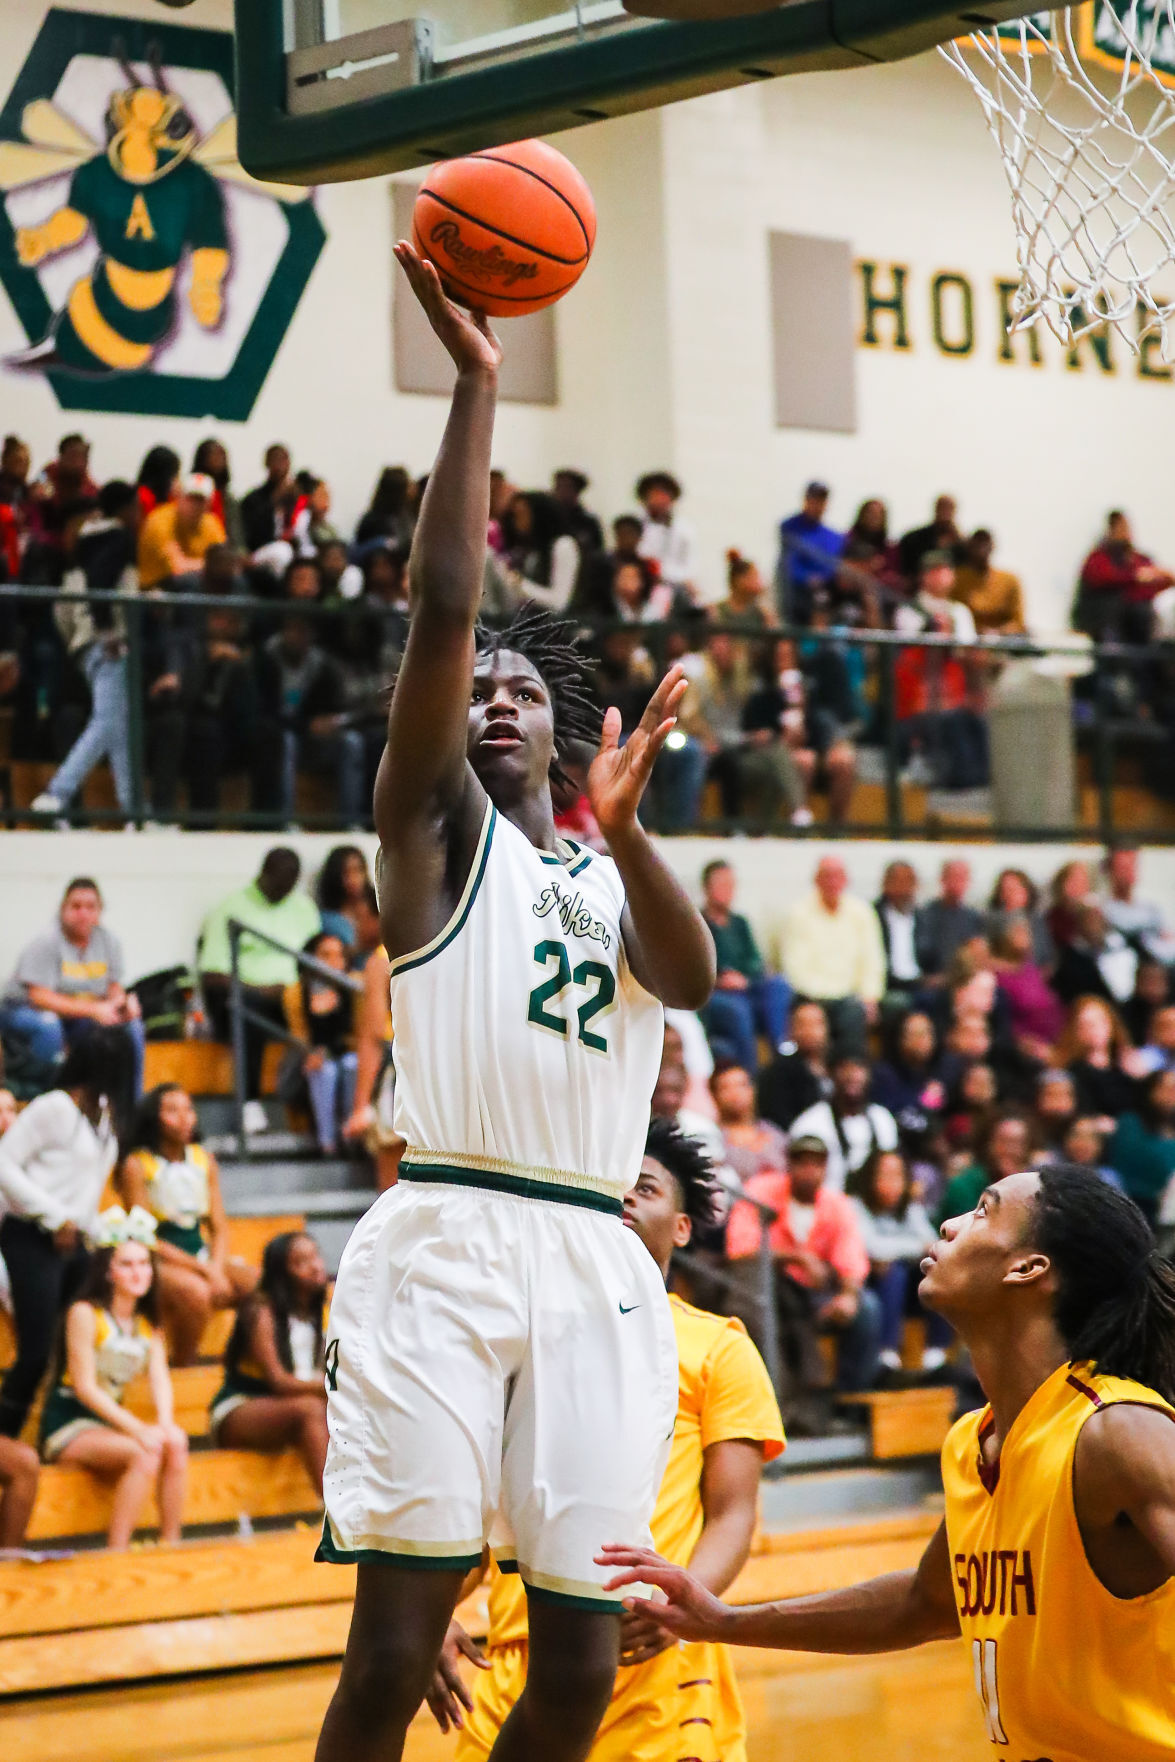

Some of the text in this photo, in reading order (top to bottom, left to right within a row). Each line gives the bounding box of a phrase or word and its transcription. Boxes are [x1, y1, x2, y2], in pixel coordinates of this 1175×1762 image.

[124, 191, 157, 241] A
[430, 220, 540, 287] Rawlings
[526, 938, 619, 1059] 22
[954, 1550, 1037, 1617] SOUTH
